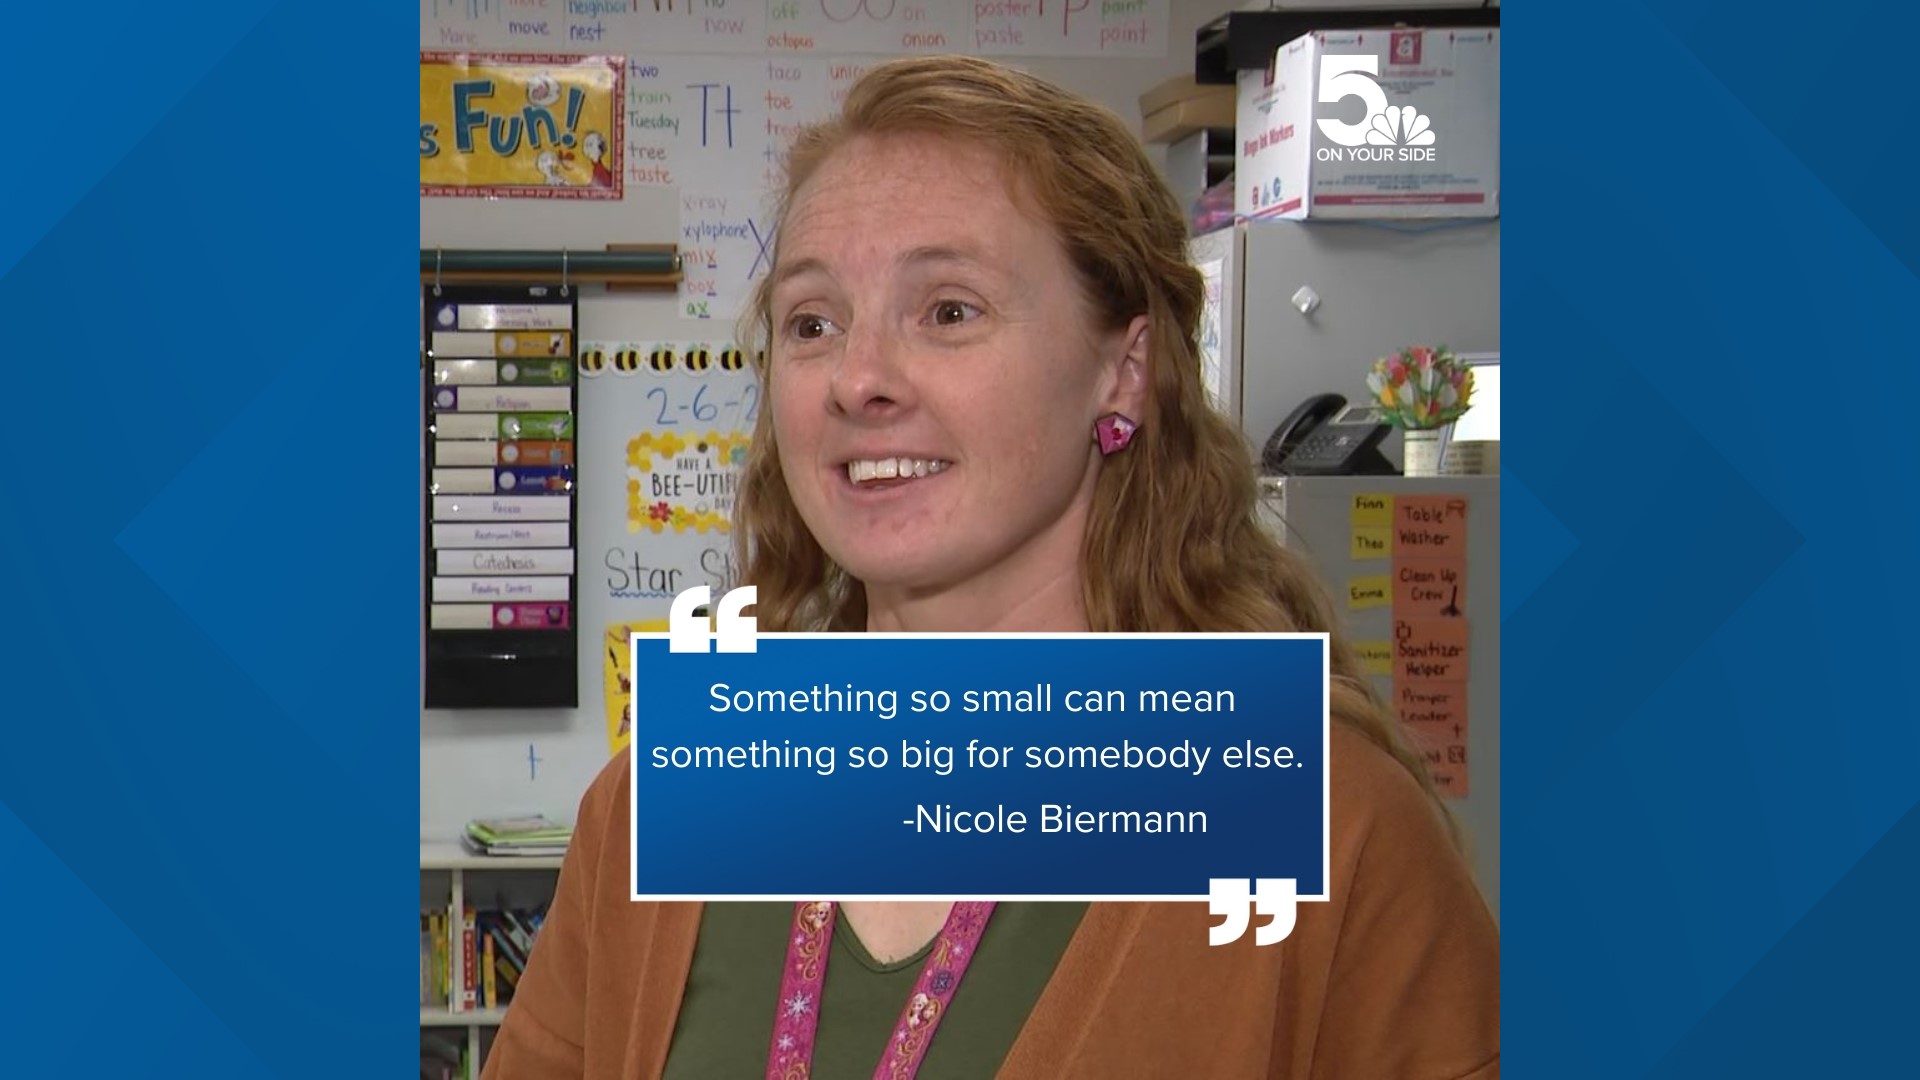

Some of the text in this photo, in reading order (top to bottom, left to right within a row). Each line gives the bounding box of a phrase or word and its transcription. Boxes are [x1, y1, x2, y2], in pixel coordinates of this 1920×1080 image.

[508, 20, 551, 36] move
[569, 19, 606, 41] nest
[704, 17, 744, 35] now
[766, 31, 815, 49] octopus
[902, 25, 946, 47] onion
[630, 60, 659, 78] two
[766, 59, 802, 81] taco
[764, 88, 793, 111] toe
[452, 81, 583, 155] Fun!
[627, 111, 680, 136] Tuesday
[629, 143, 667, 160] tree
[683, 219, 750, 243] xylophone
[683, 248, 717, 268] mix
[686, 278, 717, 296] box
[686, 300, 710, 319] ax
[676, 458, 712, 471] HAVE A
[1355, 496, 1385, 510] Finn
[1403, 504, 1445, 524] Table
[1356, 535, 1385, 549] Theo
[1399, 528, 1450, 546] Washer
[604, 546, 683, 594] Star
[1399, 567, 1457, 584] Clean Up
[1350, 587, 1385, 600] Emma
[1410, 585, 1444, 601] Crew
[1398, 639, 1464, 658] Sanitizer
[1405, 661, 1451, 677] Helper
[1401, 687, 1450, 705] Prayer
